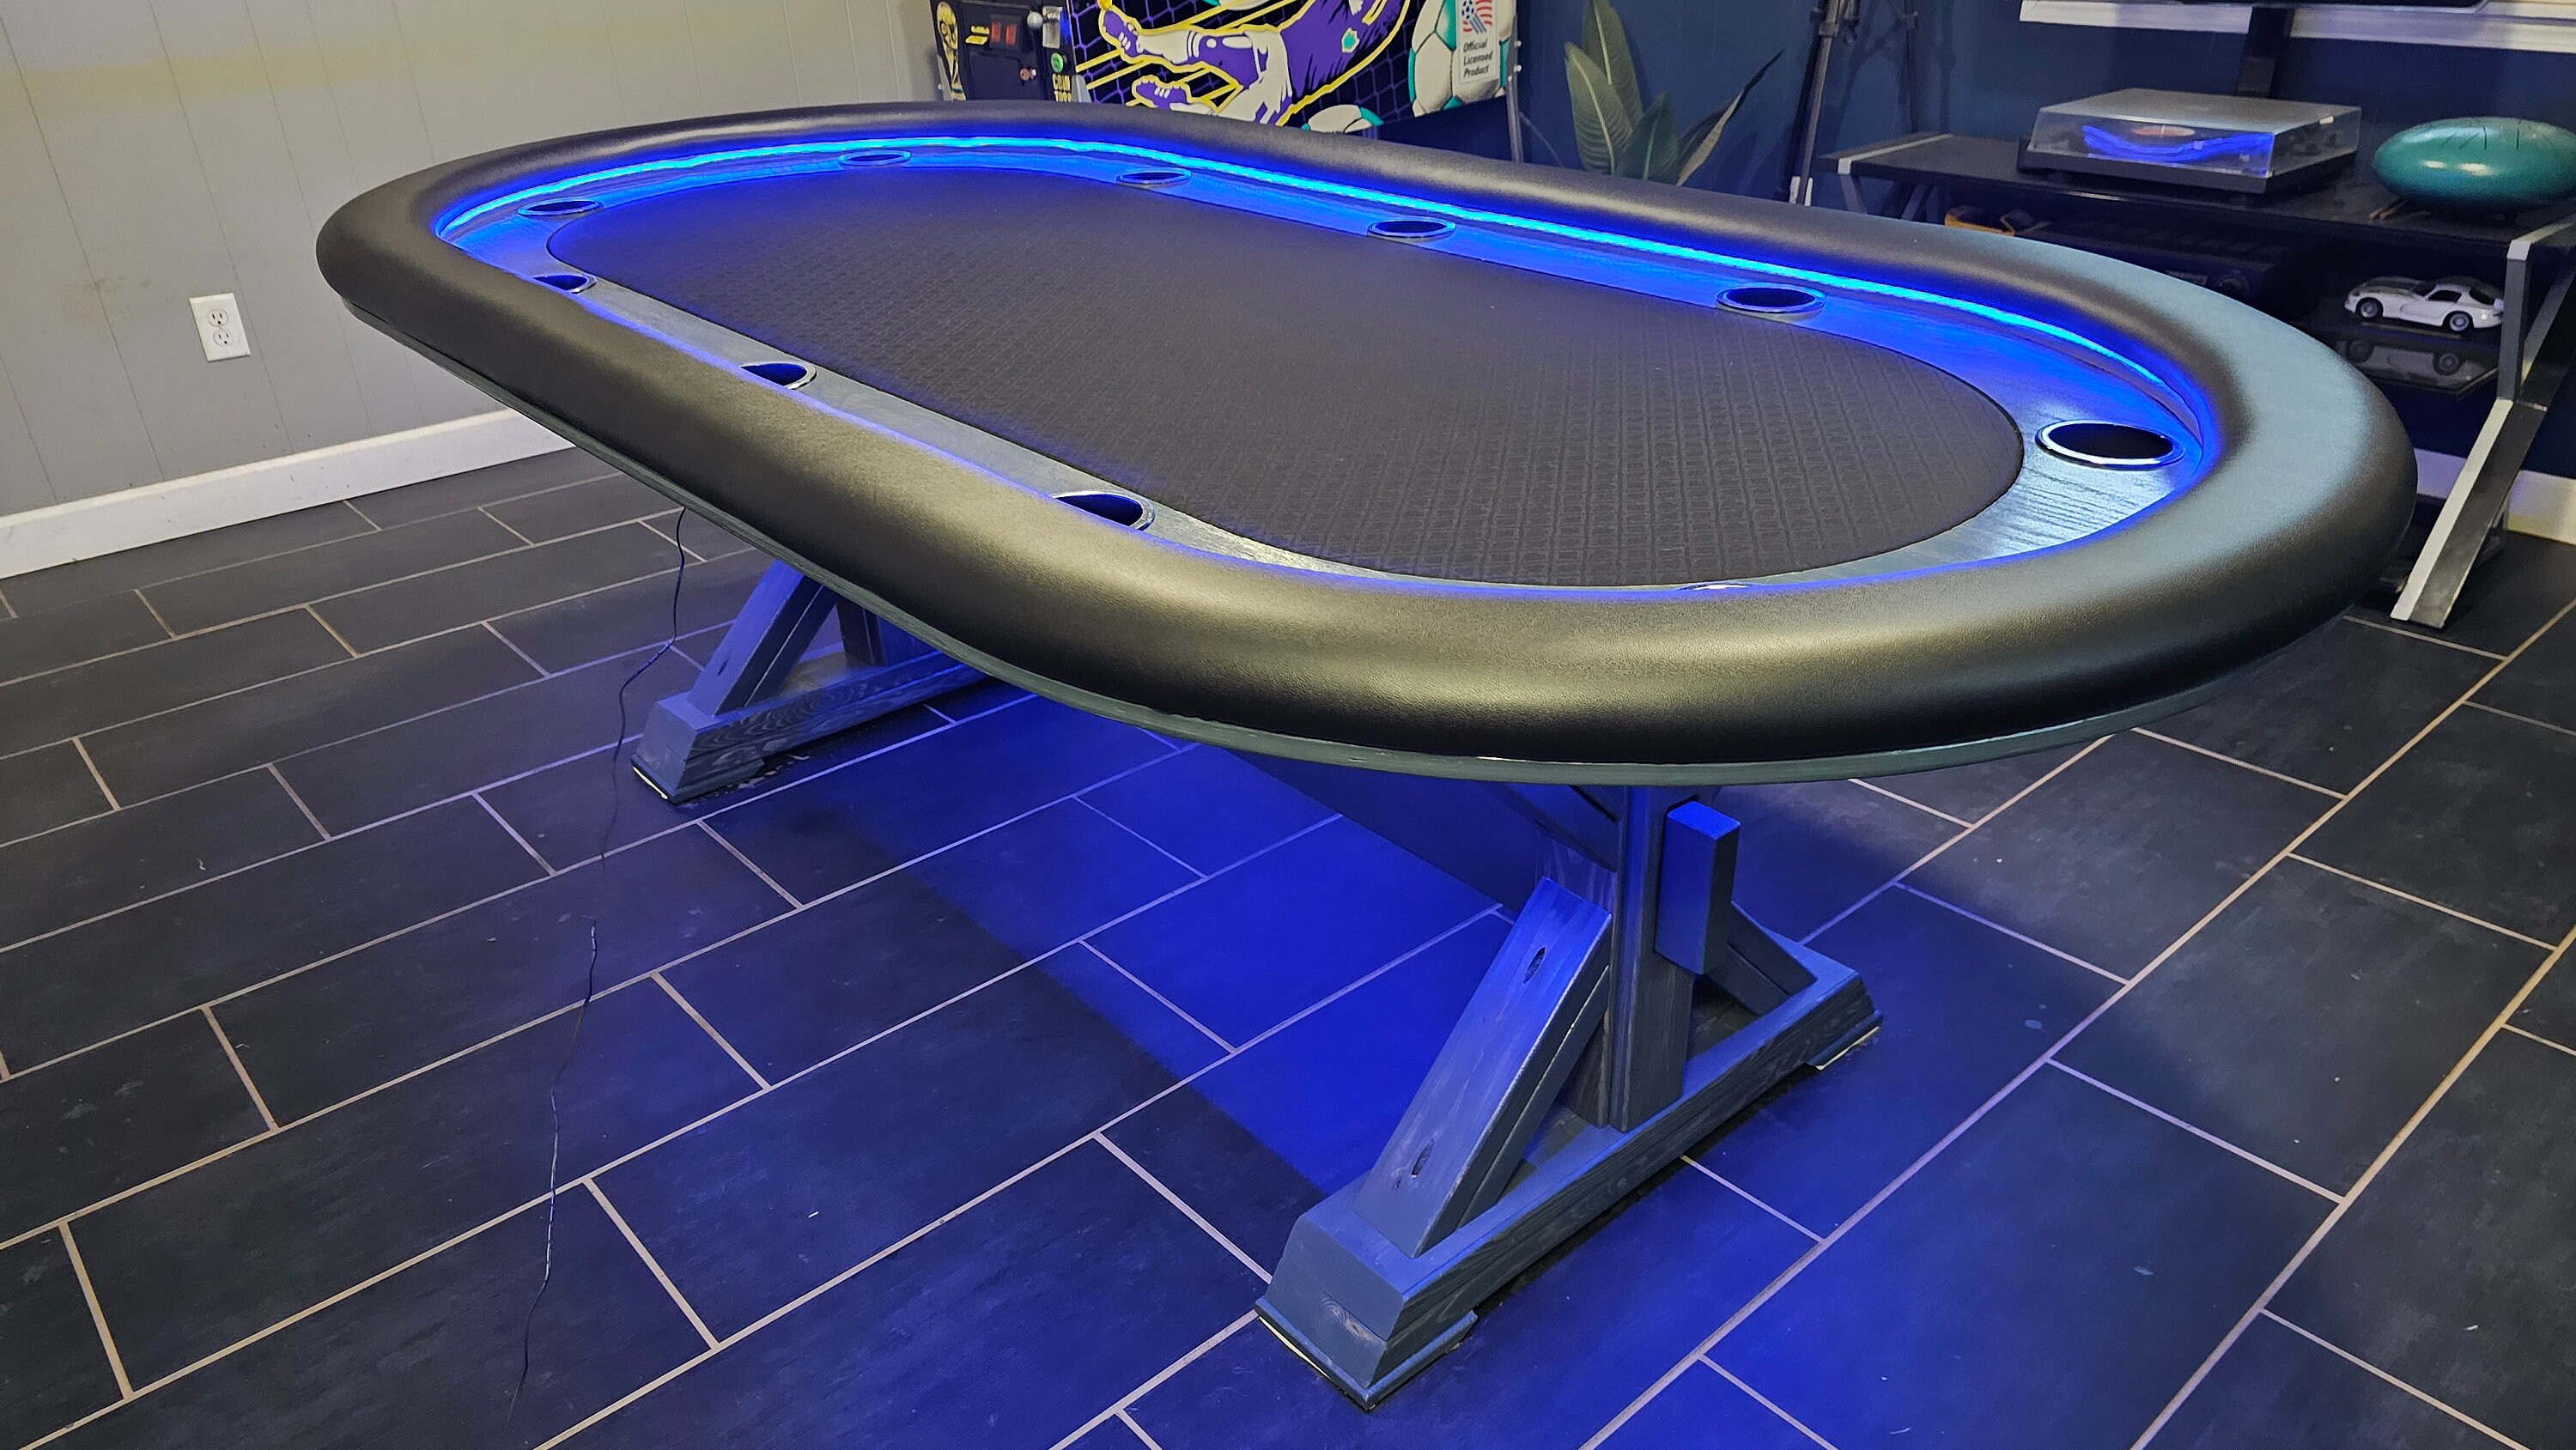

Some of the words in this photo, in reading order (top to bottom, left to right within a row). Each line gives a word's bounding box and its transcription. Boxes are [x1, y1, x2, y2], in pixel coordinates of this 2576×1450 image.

[1463, 39, 1487, 52] Official
[1463, 50, 1493, 66] Licensed
[1463, 64, 1490, 79] Product
